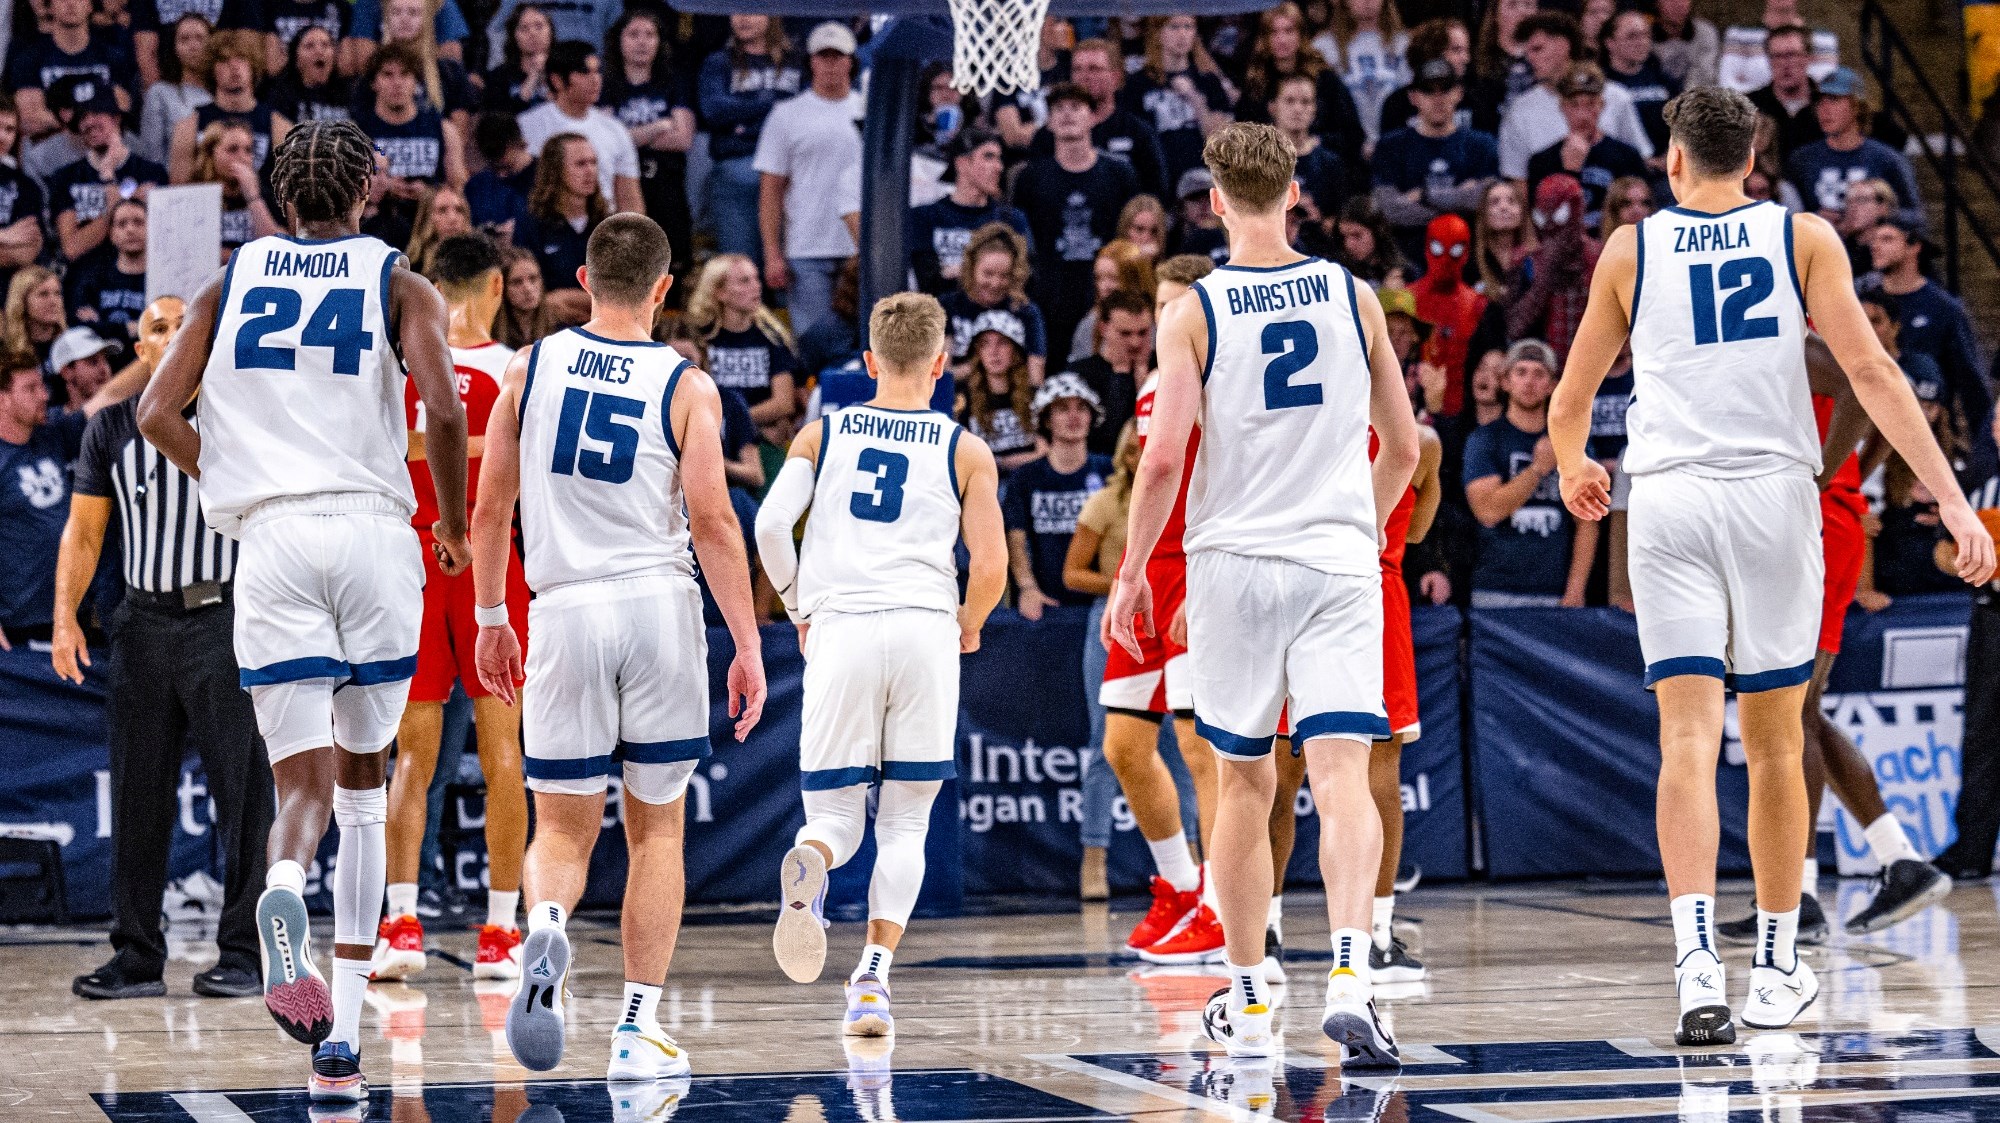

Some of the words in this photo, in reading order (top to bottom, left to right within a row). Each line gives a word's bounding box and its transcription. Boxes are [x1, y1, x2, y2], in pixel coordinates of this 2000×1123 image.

[1674, 223, 1750, 253] ZAPALA
[264, 250, 349, 279] HAMODA
[1226, 274, 1330, 316] BAIRSTOW
[1688, 256, 1780, 346] 12
[234, 286, 374, 377] 24
[567, 348, 634, 385] JONES
[1260, 319, 1324, 411] 2
[550, 386, 647, 485] 15
[839, 413, 942, 446] ASHWORTH
[849, 447, 910, 524] 3
[1032, 492, 1087, 518] AGG
[959, 794, 1046, 832] gan
